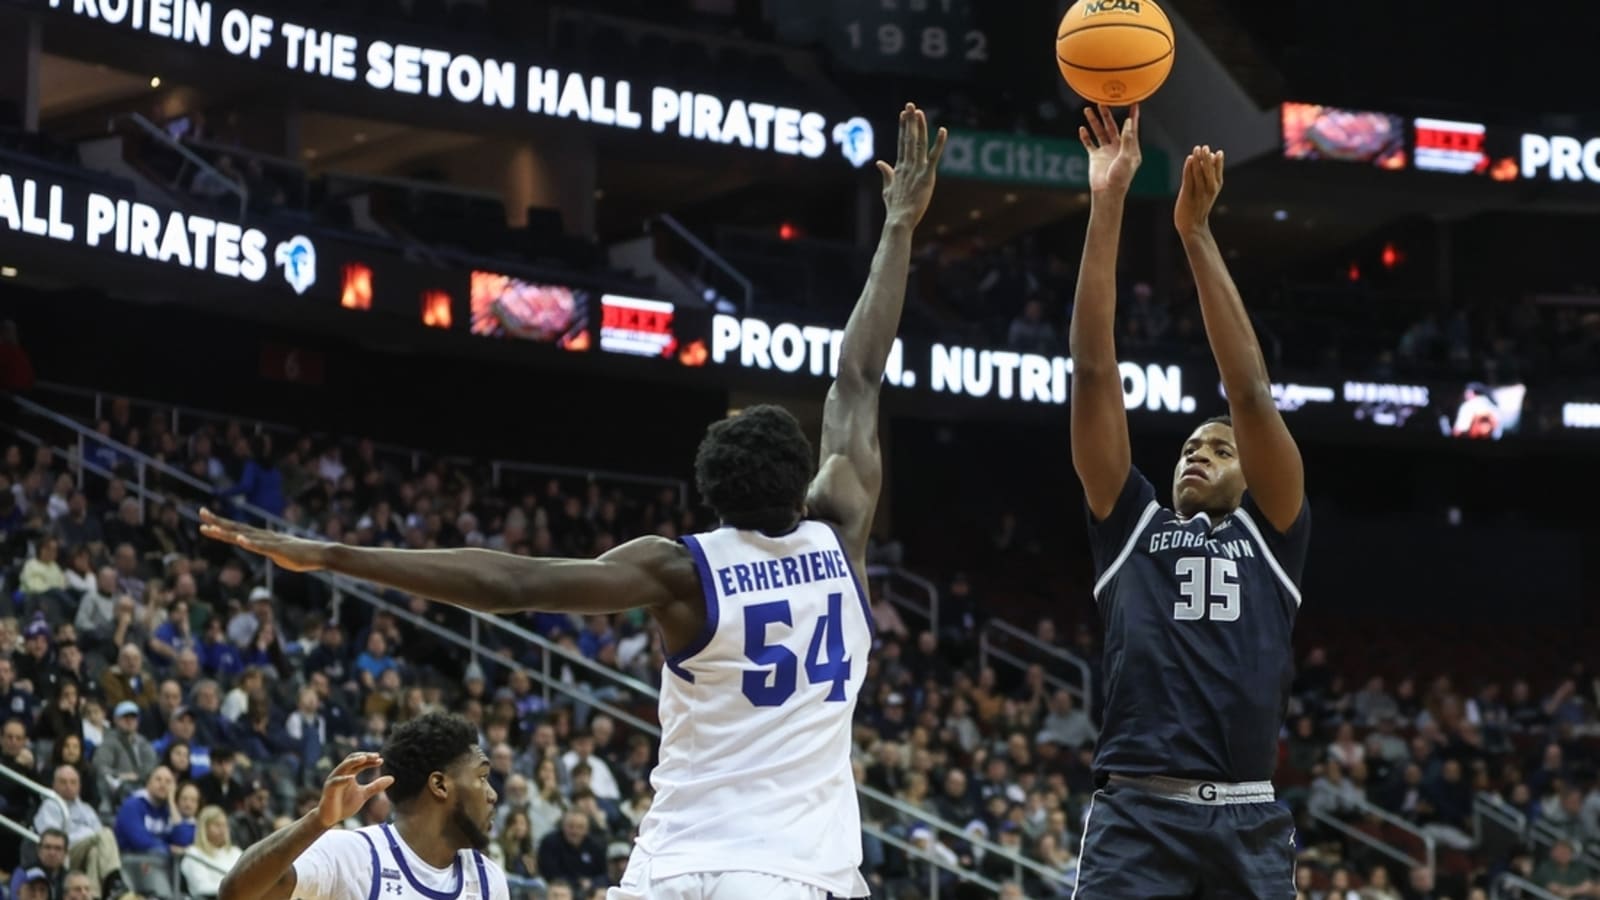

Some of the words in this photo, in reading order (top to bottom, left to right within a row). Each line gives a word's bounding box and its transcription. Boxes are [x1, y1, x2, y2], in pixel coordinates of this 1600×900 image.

[48, 0, 212, 47] OTEIN
[222, 9, 274, 58] OF
[282, 23, 358, 81] THE
[365, 41, 516, 109] SETON
[527, 66, 642, 129] HALL
[651, 87, 827, 158] PIRATES
[980, 139, 1089, 182] Citize
[1520, 133, 1600, 184] PRO
[0, 173, 75, 241] ALL
[86, 192, 267, 282] PIRATES
[711, 313, 917, 388] PROTN.
[931, 343, 1197, 414] NUTRION.
[718, 550, 849, 597] ERHERIENE
[1149, 529, 1254, 560] GEORGTWN
[1173, 556, 1241, 622] 35
[741, 592, 853, 708] 54
[1197, 783, 1218, 802] G
